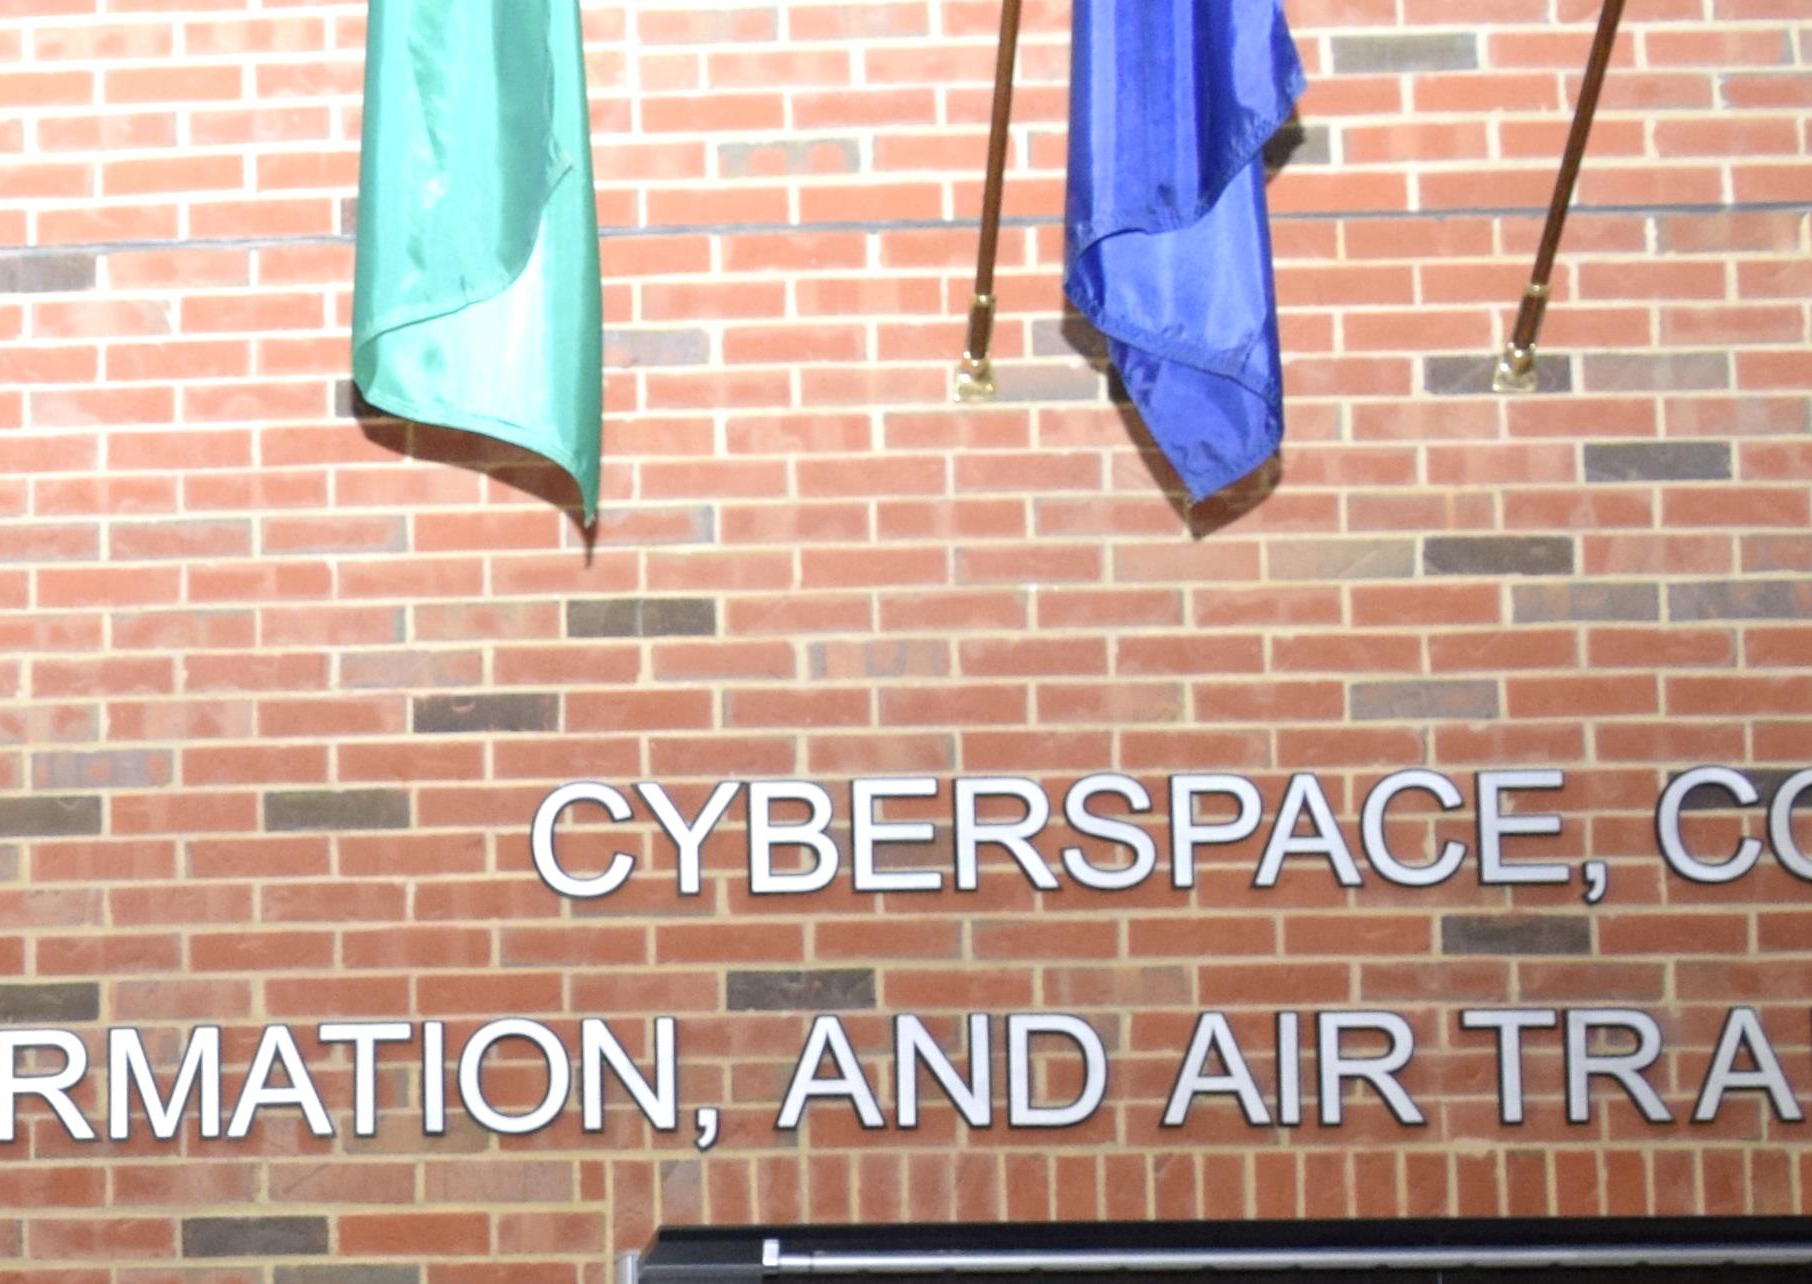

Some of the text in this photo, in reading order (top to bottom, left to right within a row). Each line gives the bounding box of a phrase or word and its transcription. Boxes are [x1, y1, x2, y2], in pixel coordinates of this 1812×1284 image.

[530, 768, 1609, 905] CYBERSPACE,
[776, 1011, 1109, 1133] AND
[1159, 1008, 1429, 1129] AIR
[1460, 1003, 1812, 1127] TRA
